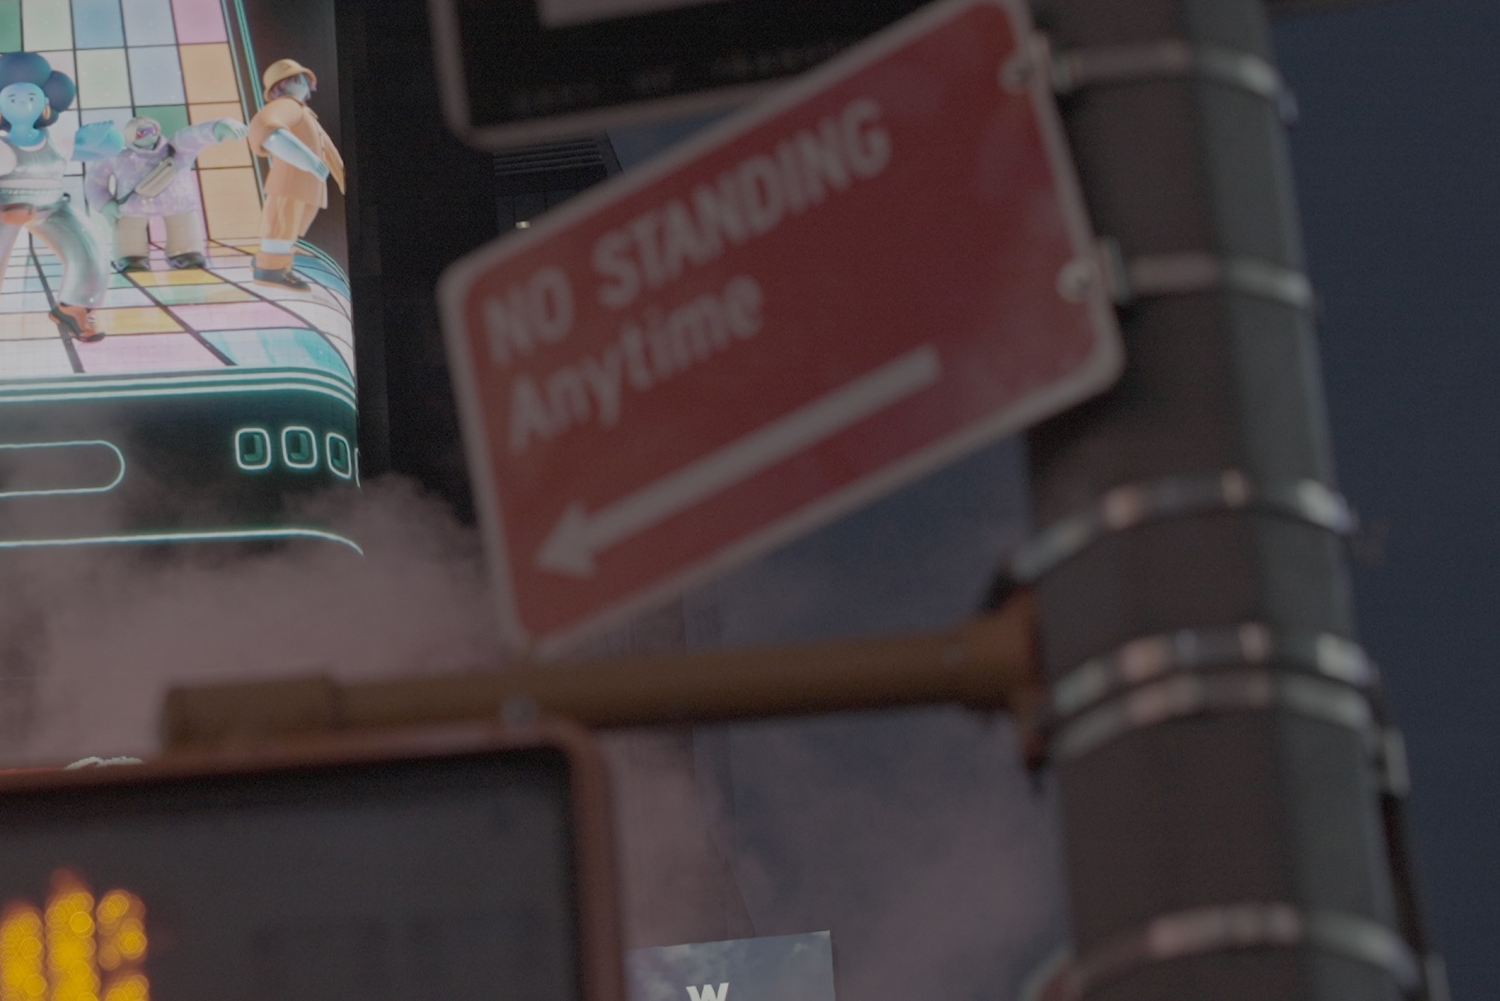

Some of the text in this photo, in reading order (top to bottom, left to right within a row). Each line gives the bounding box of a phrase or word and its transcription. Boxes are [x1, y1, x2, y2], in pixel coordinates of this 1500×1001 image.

[480, 97, 893, 369] NO STANDING
[508, 274, 766, 455] Anytime
